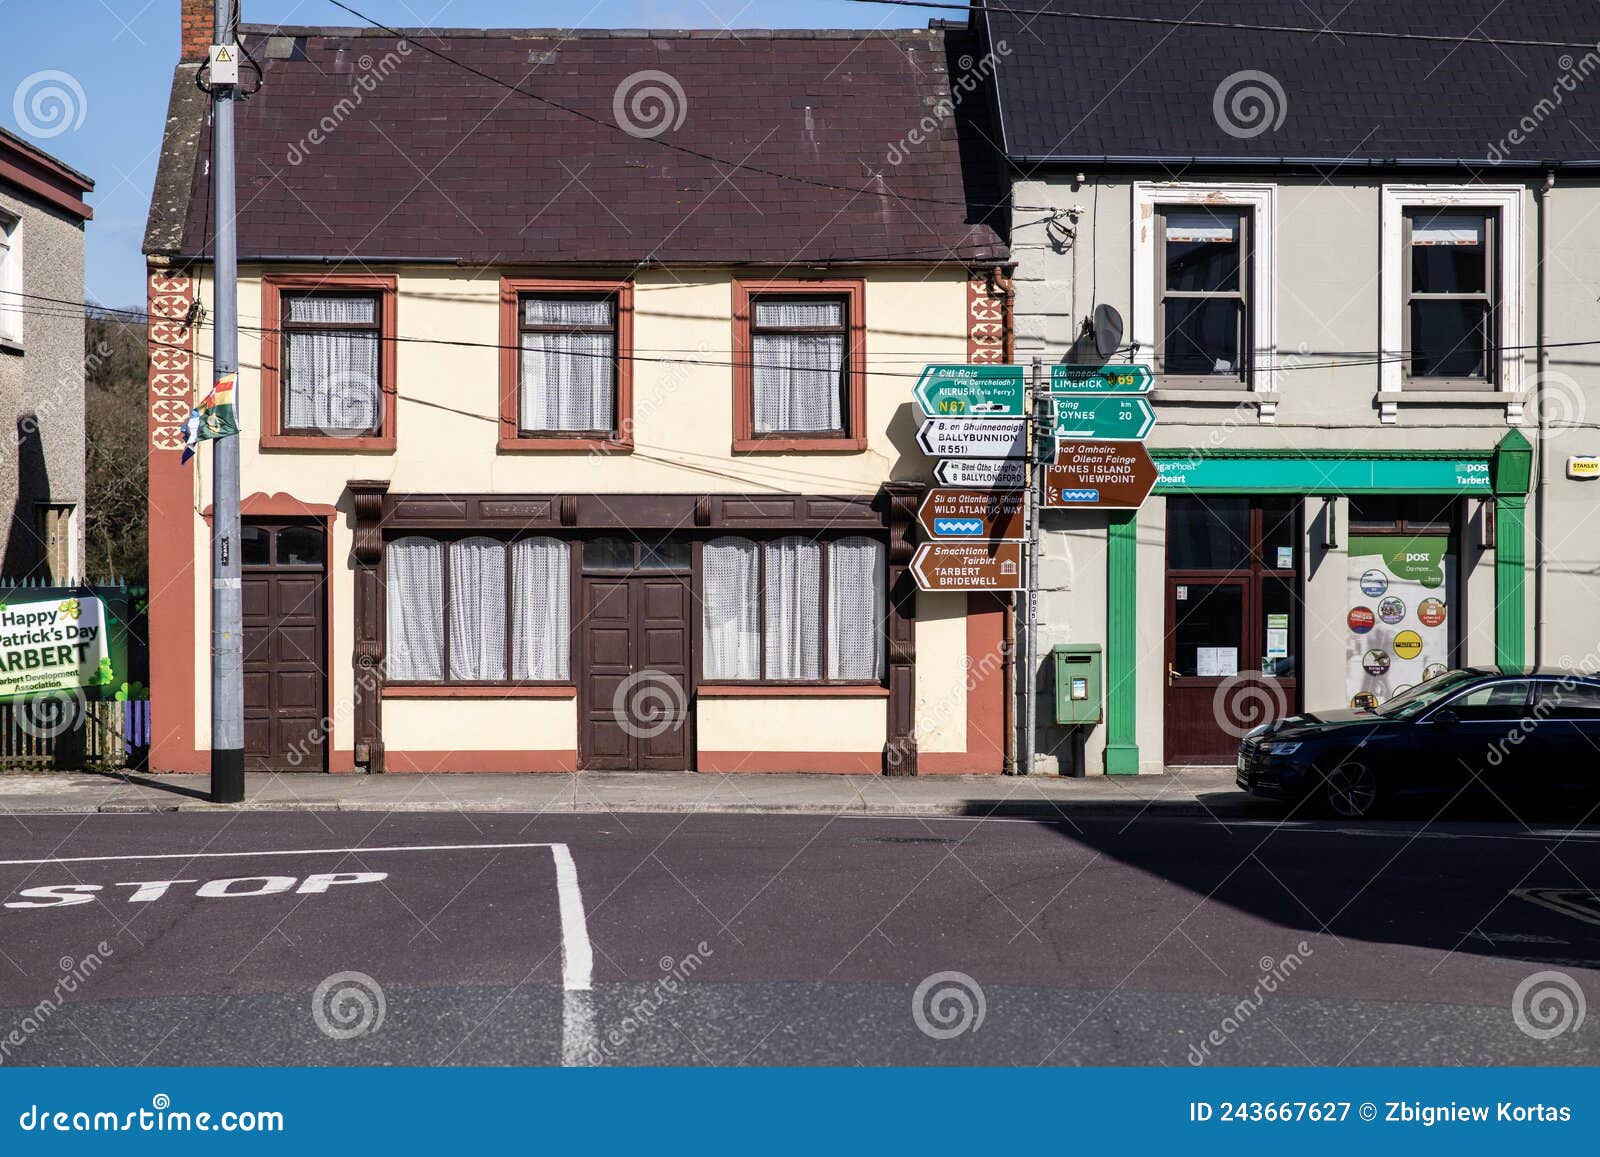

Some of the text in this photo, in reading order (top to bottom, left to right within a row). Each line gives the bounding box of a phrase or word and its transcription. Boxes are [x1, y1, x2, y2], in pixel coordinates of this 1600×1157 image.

[1054, 379, 1102, 388] LIMERICK
[939, 387, 975, 396] KILRUSH
[1119, 411, 1132, 420] 20
[939, 422, 947, 431] B.
[938, 433, 1018, 442] BALLYBUNNION
[1057, 445, 1075, 454] nad
[1048, 465, 1131, 473] FOYNES ISLAND
[1466, 463, 1489, 473] post
[952, 473, 1022, 481] 8 BALLYLONGFORD
[1079, 475, 1136, 484] VIEWPOINT
[1456, 475, 1490, 485] Tarbert
[934, 505, 1022, 514] WILD ATLANTIC WAY
[934, 547, 988, 555] Smachtlann
[963, 556, 997, 565] Tairbirt
[1406, 552, 1430, 562] post
[934, 567, 981, 576] TARBERT
[940, 577, 998, 585] BRIDEWELL
[2, 610, 58, 627] Happy
[0, 624, 98, 647] atrick's Day
[25, 669, 80, 682] Development
[14, 681, 62, 693] Association
[4, 872, 390, 908] STOP
